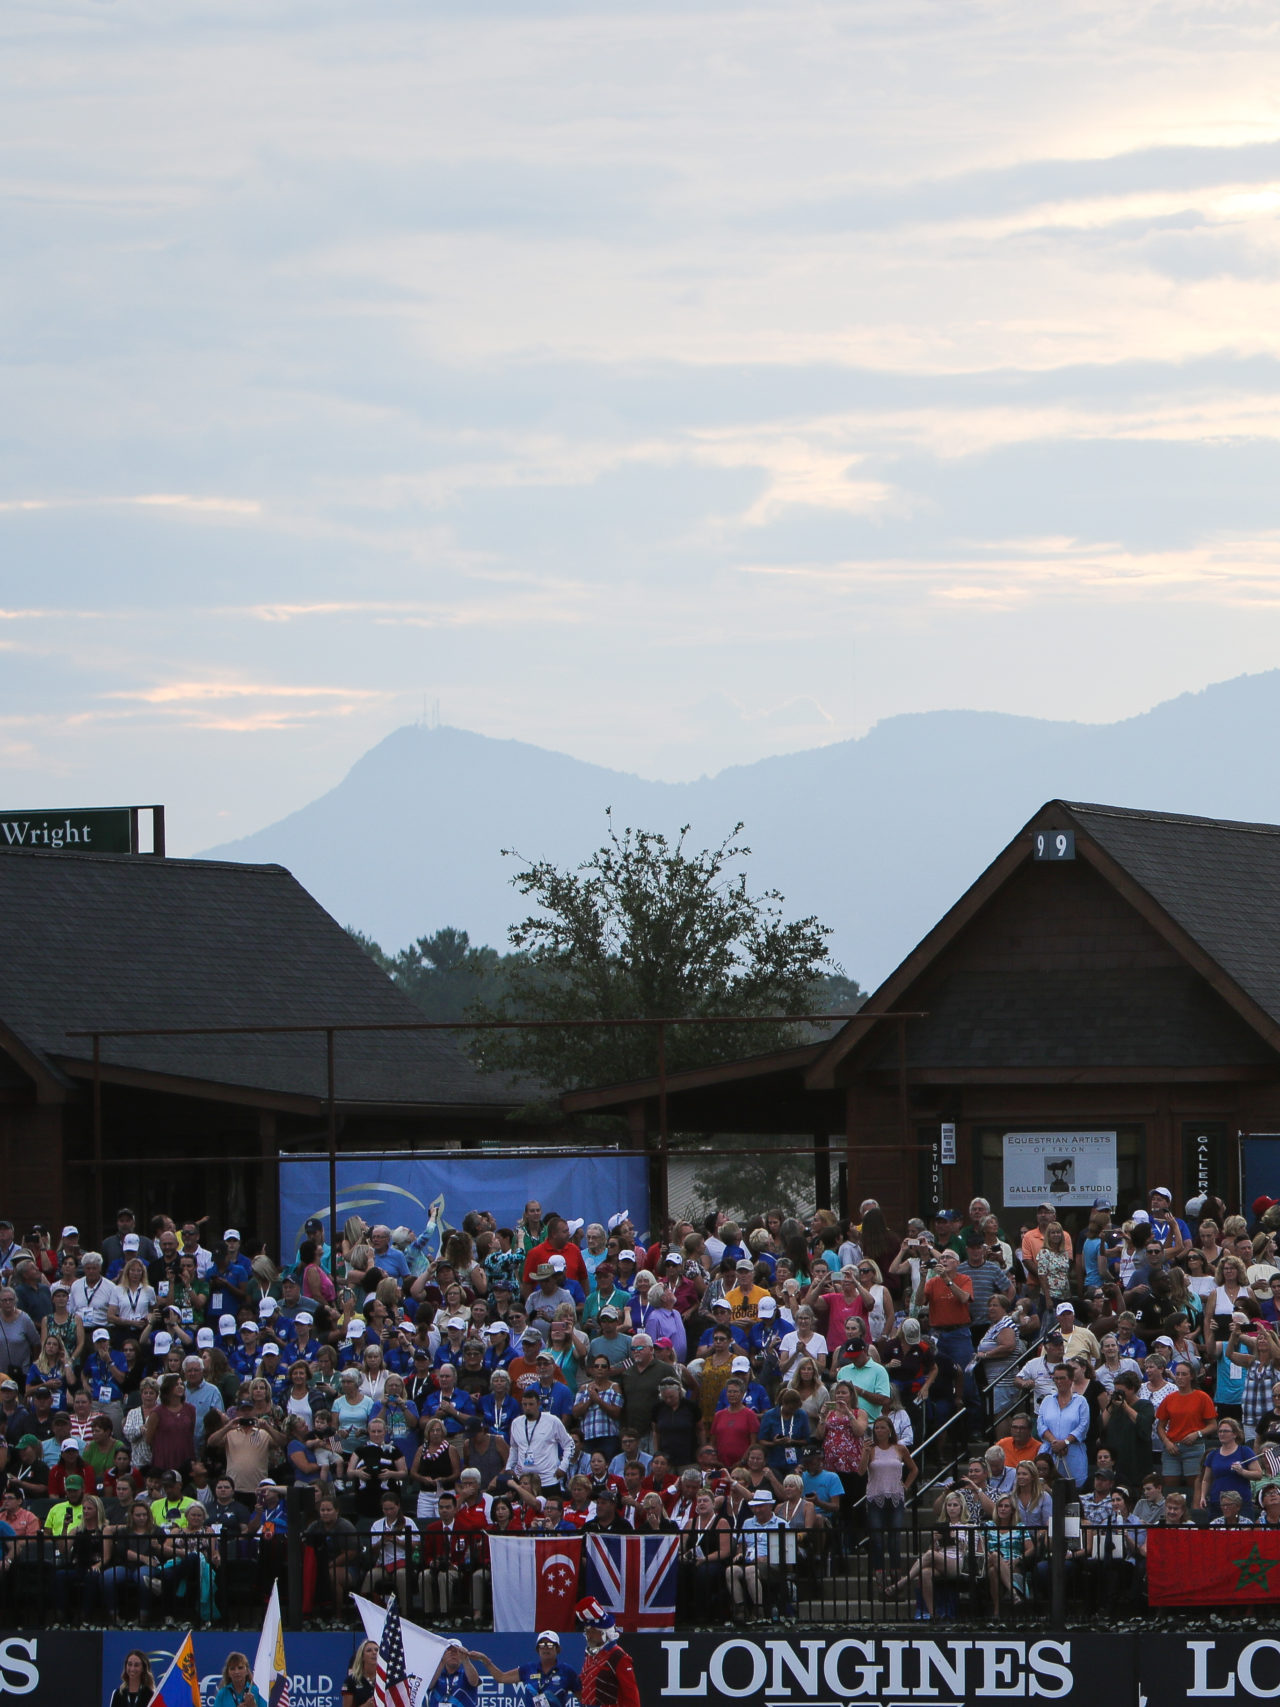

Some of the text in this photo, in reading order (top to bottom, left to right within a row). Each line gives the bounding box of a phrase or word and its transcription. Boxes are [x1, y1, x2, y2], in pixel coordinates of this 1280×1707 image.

[1, 820, 91, 848] Wright
[1008, 1136, 1111, 1145] EQUESTRIAN ARTISTS
[931, 1143, 939, 1204] STUDIO
[1009, 1185, 1048, 1193] GALLERY
[661, 1638, 1074, 1699] LONGINES
